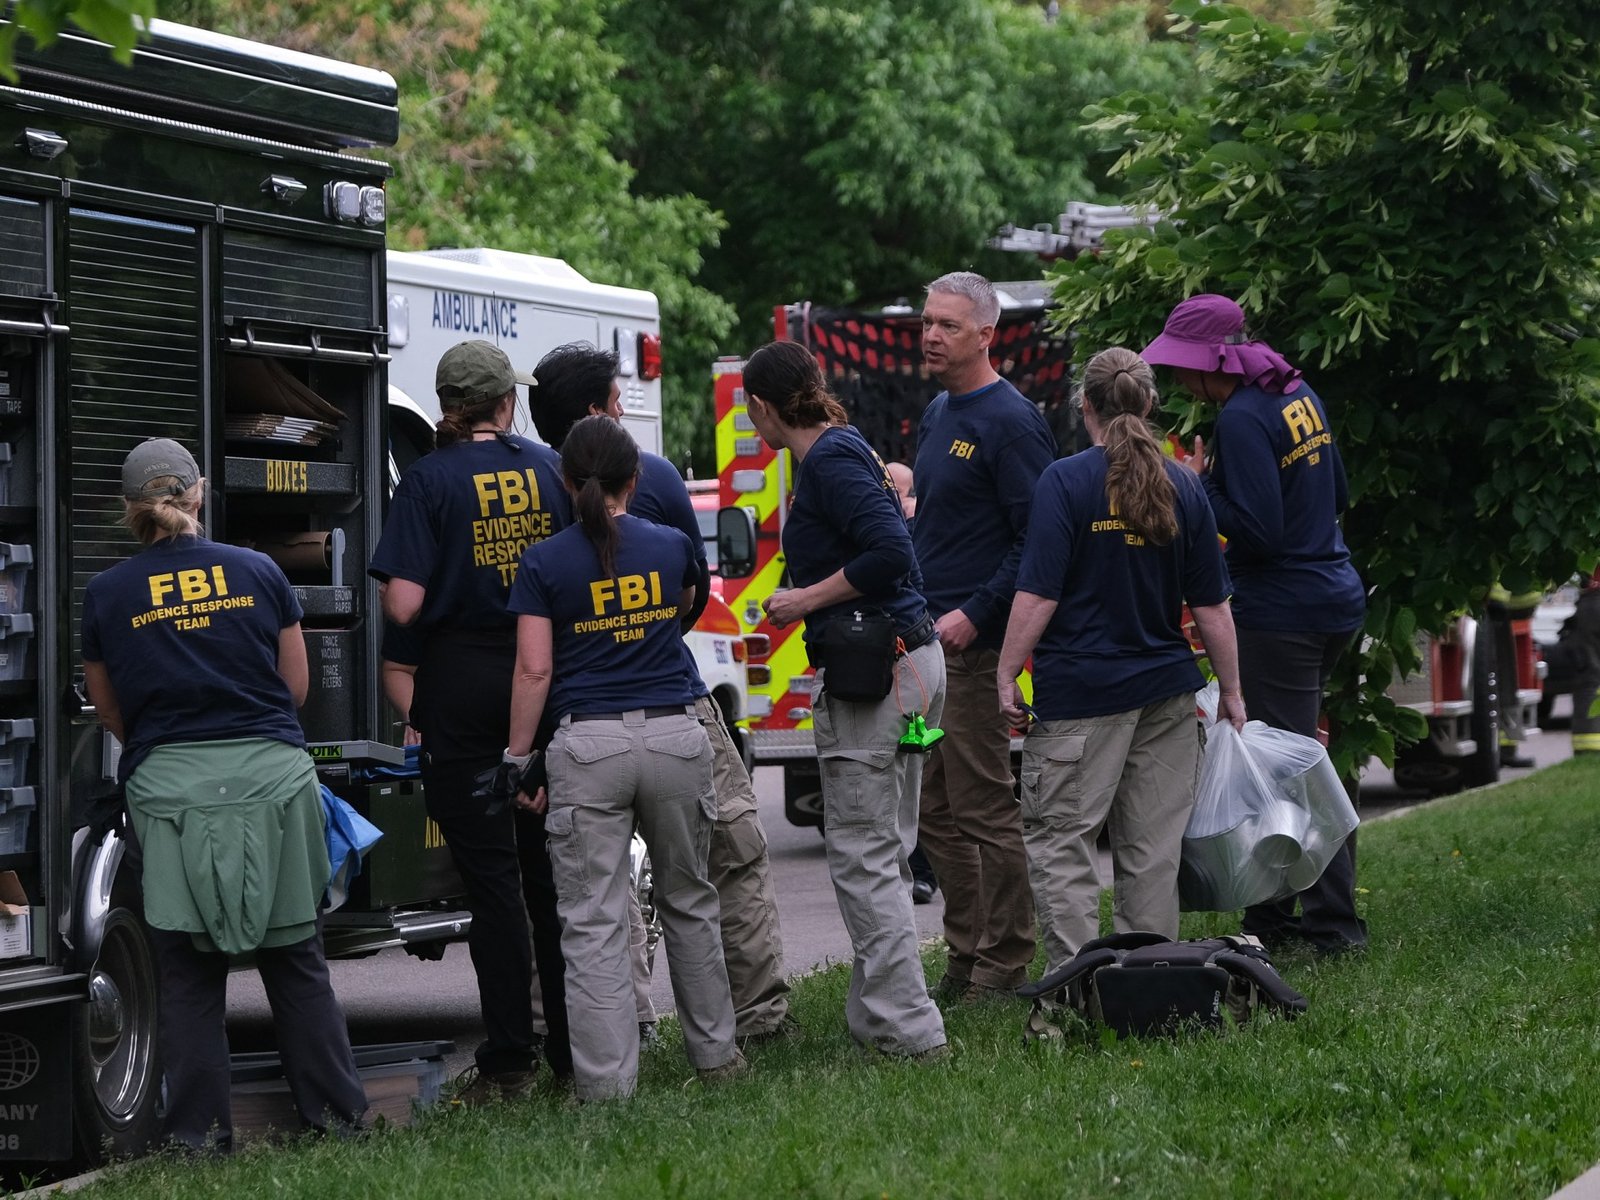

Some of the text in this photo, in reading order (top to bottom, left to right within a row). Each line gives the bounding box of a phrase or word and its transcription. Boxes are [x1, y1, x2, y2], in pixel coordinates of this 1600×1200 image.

[432, 290, 518, 338] AMBULANCE
[6, 400, 22, 413] TAPE
[1281, 396, 1325, 444] FBI
[948, 439, 976, 460] FBI
[266, 460, 307, 493] BOXES
[473, 469, 541, 517] FBI
[473, 513, 551, 543] EVIDENCE
[1091, 520, 1134, 532] EVIDEN
[473, 537, 545, 567] RESPO
[148, 565, 228, 606] FBI
[590, 571, 661, 615] FBI
[335, 589, 352, 601] BROWN
[131, 596, 254, 628] EVIDENCE RESPONSE
[335, 601, 352, 613] PAPER
[174, 616, 211, 631] TEAM
[574, 615, 627, 633] EVIDENCE
[322, 636, 338, 647] TRACE
[613, 627, 644, 643] TEAM
[321, 648, 341, 659] VACUUM
[322, 664, 339, 676] TRACE
[322, 676, 343, 688] FILTERS
